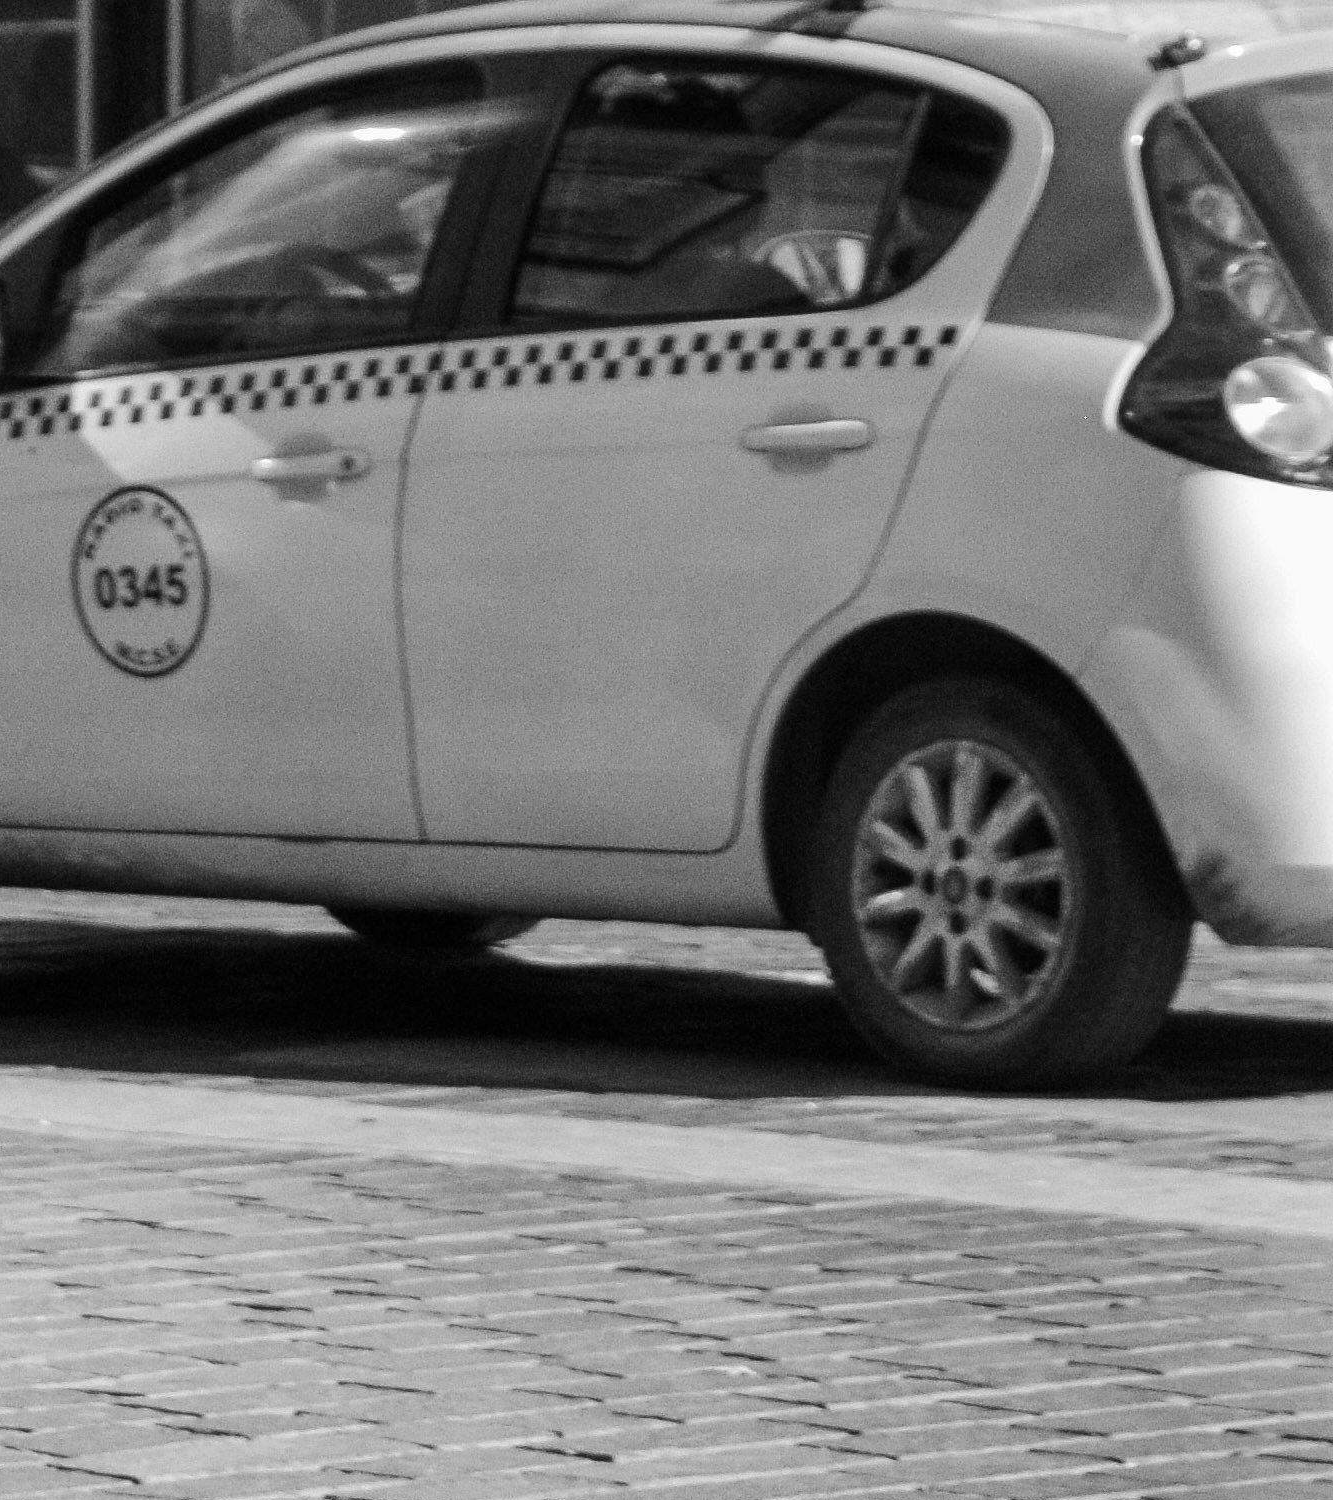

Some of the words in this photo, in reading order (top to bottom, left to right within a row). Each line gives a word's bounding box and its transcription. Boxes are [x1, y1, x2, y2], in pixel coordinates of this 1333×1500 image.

[85, 497, 144, 560] RADIO
[149, 502, 194, 559] TAXI
[93, 564, 188, 609] 0345
